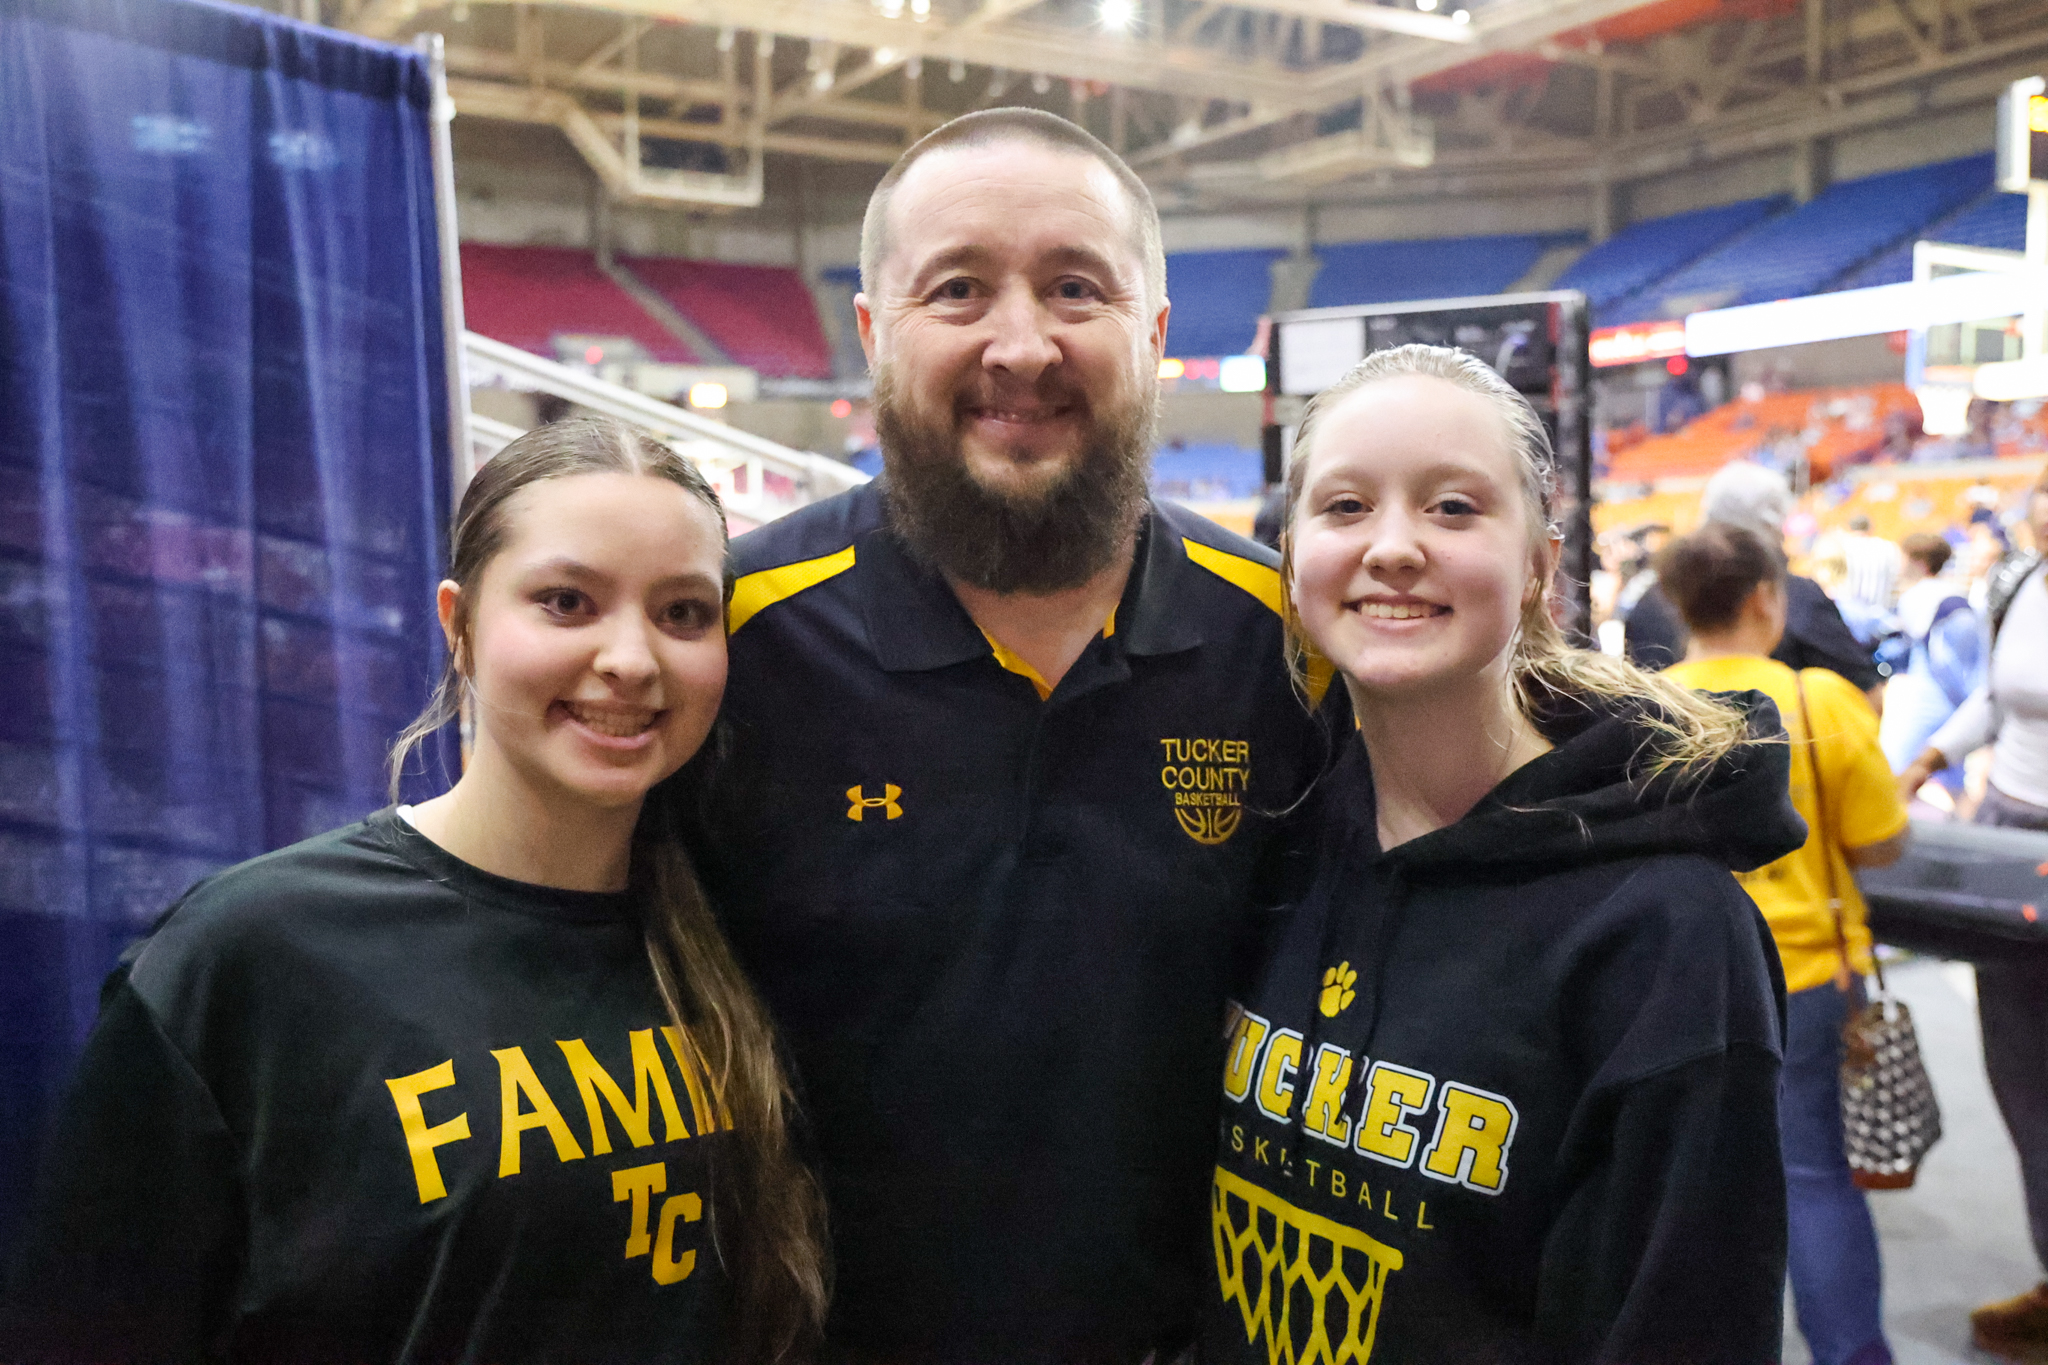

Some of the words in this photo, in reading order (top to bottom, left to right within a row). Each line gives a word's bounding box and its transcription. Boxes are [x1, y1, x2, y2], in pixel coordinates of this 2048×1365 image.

[1160, 738, 1250, 763] TUCKER
[1161, 765, 1250, 791] COUNTY
[1174, 792, 1241, 806] BASKETBALL
[385, 1026, 734, 1204] FAMI
[1224, 1000, 1519, 1196] UCKER
[611, 1162, 702, 1286] TC
